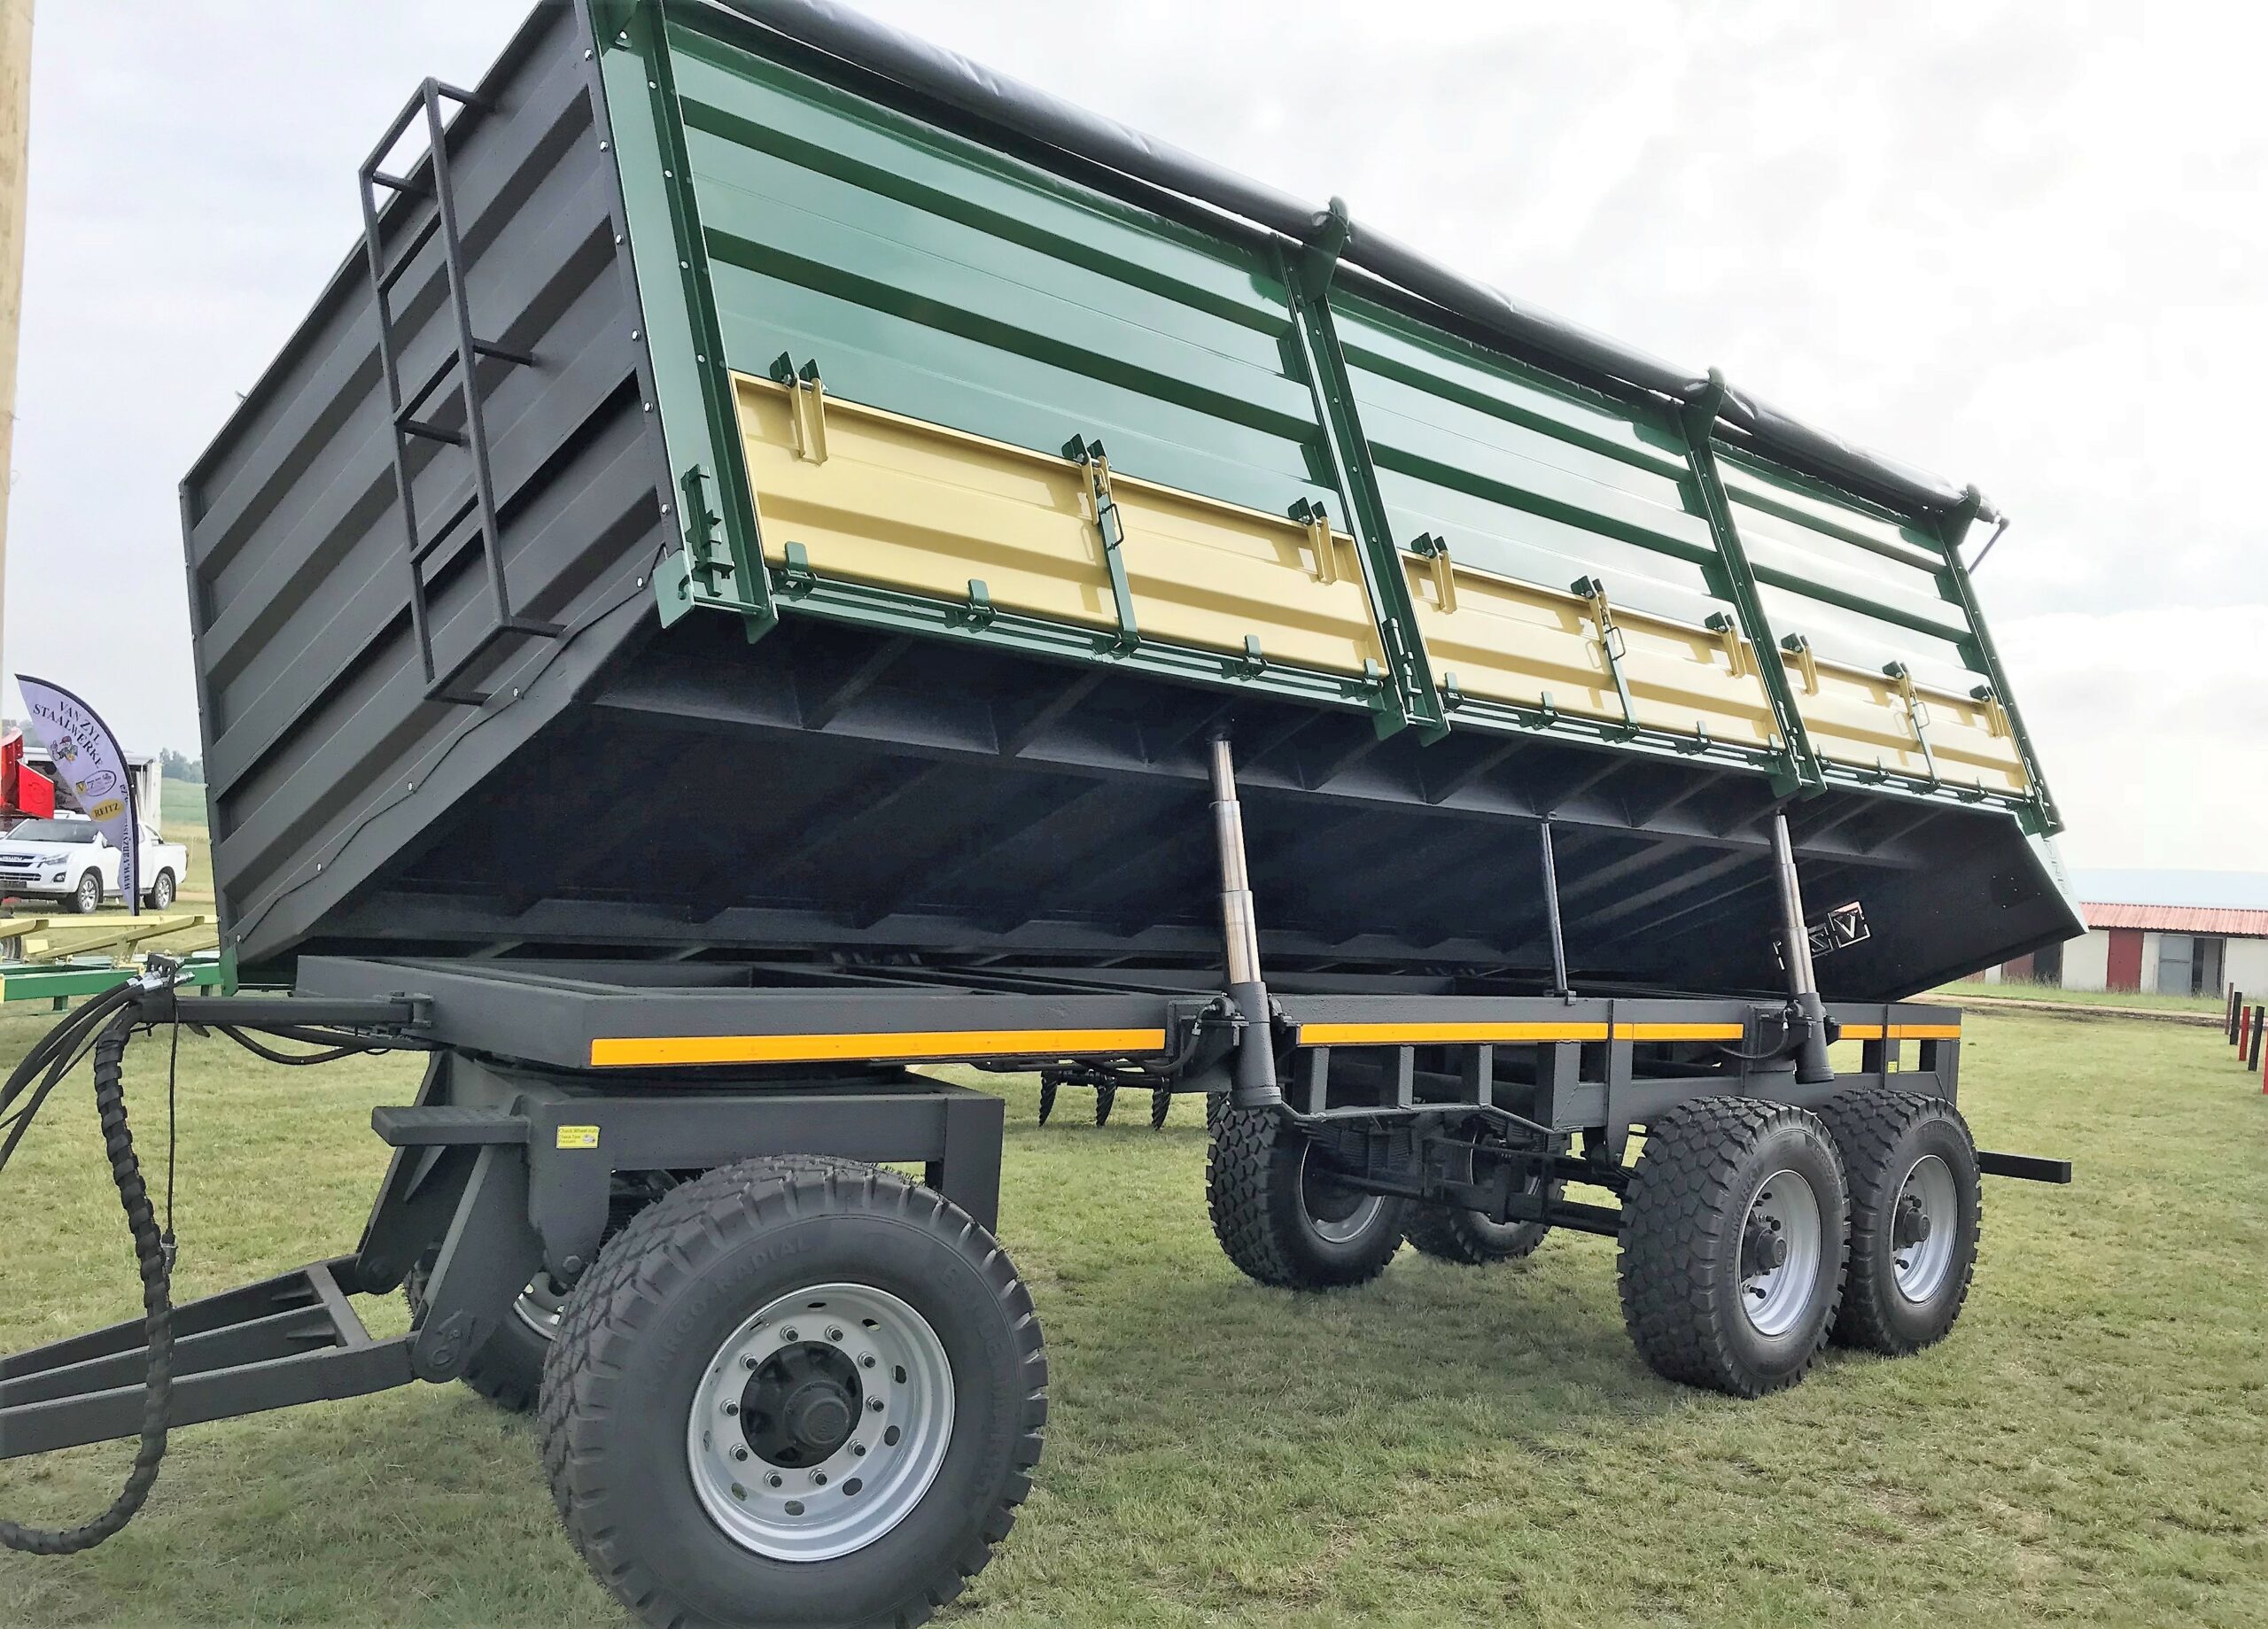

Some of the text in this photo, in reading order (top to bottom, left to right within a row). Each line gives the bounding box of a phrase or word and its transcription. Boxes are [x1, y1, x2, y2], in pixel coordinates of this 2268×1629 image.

[33, 703, 104, 769] STAALWERKE
[60, 701, 100, 746] VAN ZYL
[94, 803, 118, 817] REITZ
